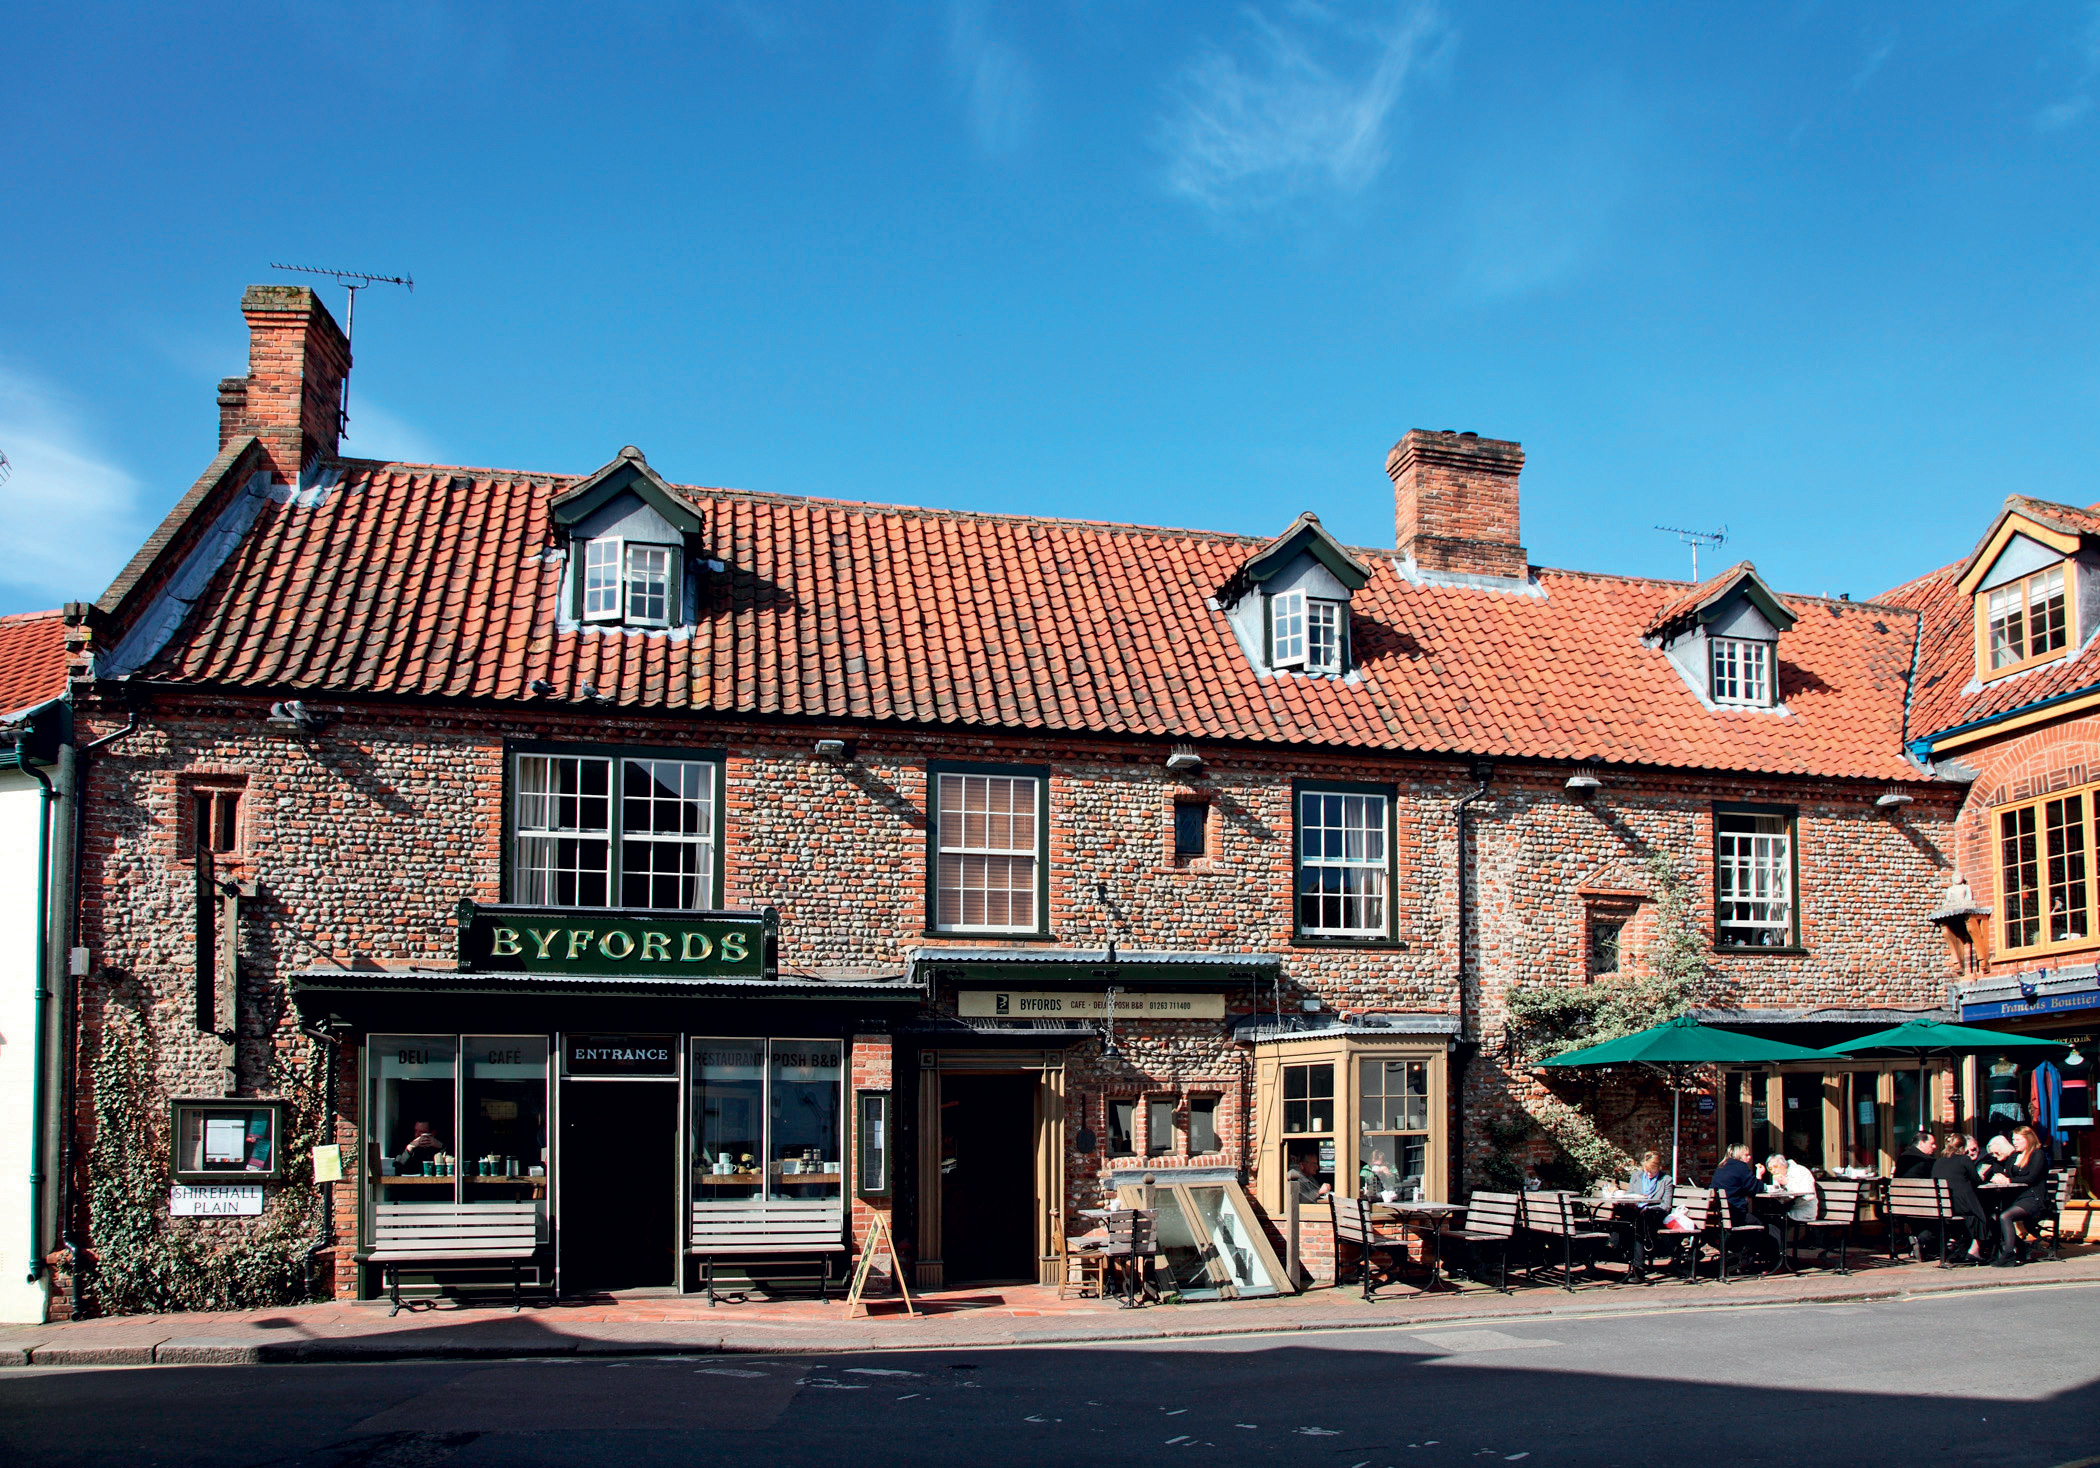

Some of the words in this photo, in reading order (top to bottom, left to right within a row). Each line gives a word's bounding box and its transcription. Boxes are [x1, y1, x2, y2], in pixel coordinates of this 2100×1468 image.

[490, 926, 749, 963] BYFORDS
[1020, 998, 1062, 1011] BYFORDS
[1070, 1001, 1086, 1009] CAFE
[1114, 1001, 1130, 1010] POSH
[1131, 1001, 1144, 1010] B&B
[1149, 1002, 1168, 1010] 01263
[1169, 1002, 1191, 1010] 711400
[2051, 994, 2098, 1008] Bouttier
[398, 1049, 429, 1065] DELI
[487, 1047, 522, 1065] CAFÉ
[575, 1048, 669, 1061] ENTRANCE
[694, 1051, 763, 1067] RESTAURANT
[772, 1053, 806, 1067] POSH
[811, 1053, 839, 1068] B&B
[174, 1187, 259, 1199] SHIREHALL
[193, 1201, 240, 1214] PLAIN
